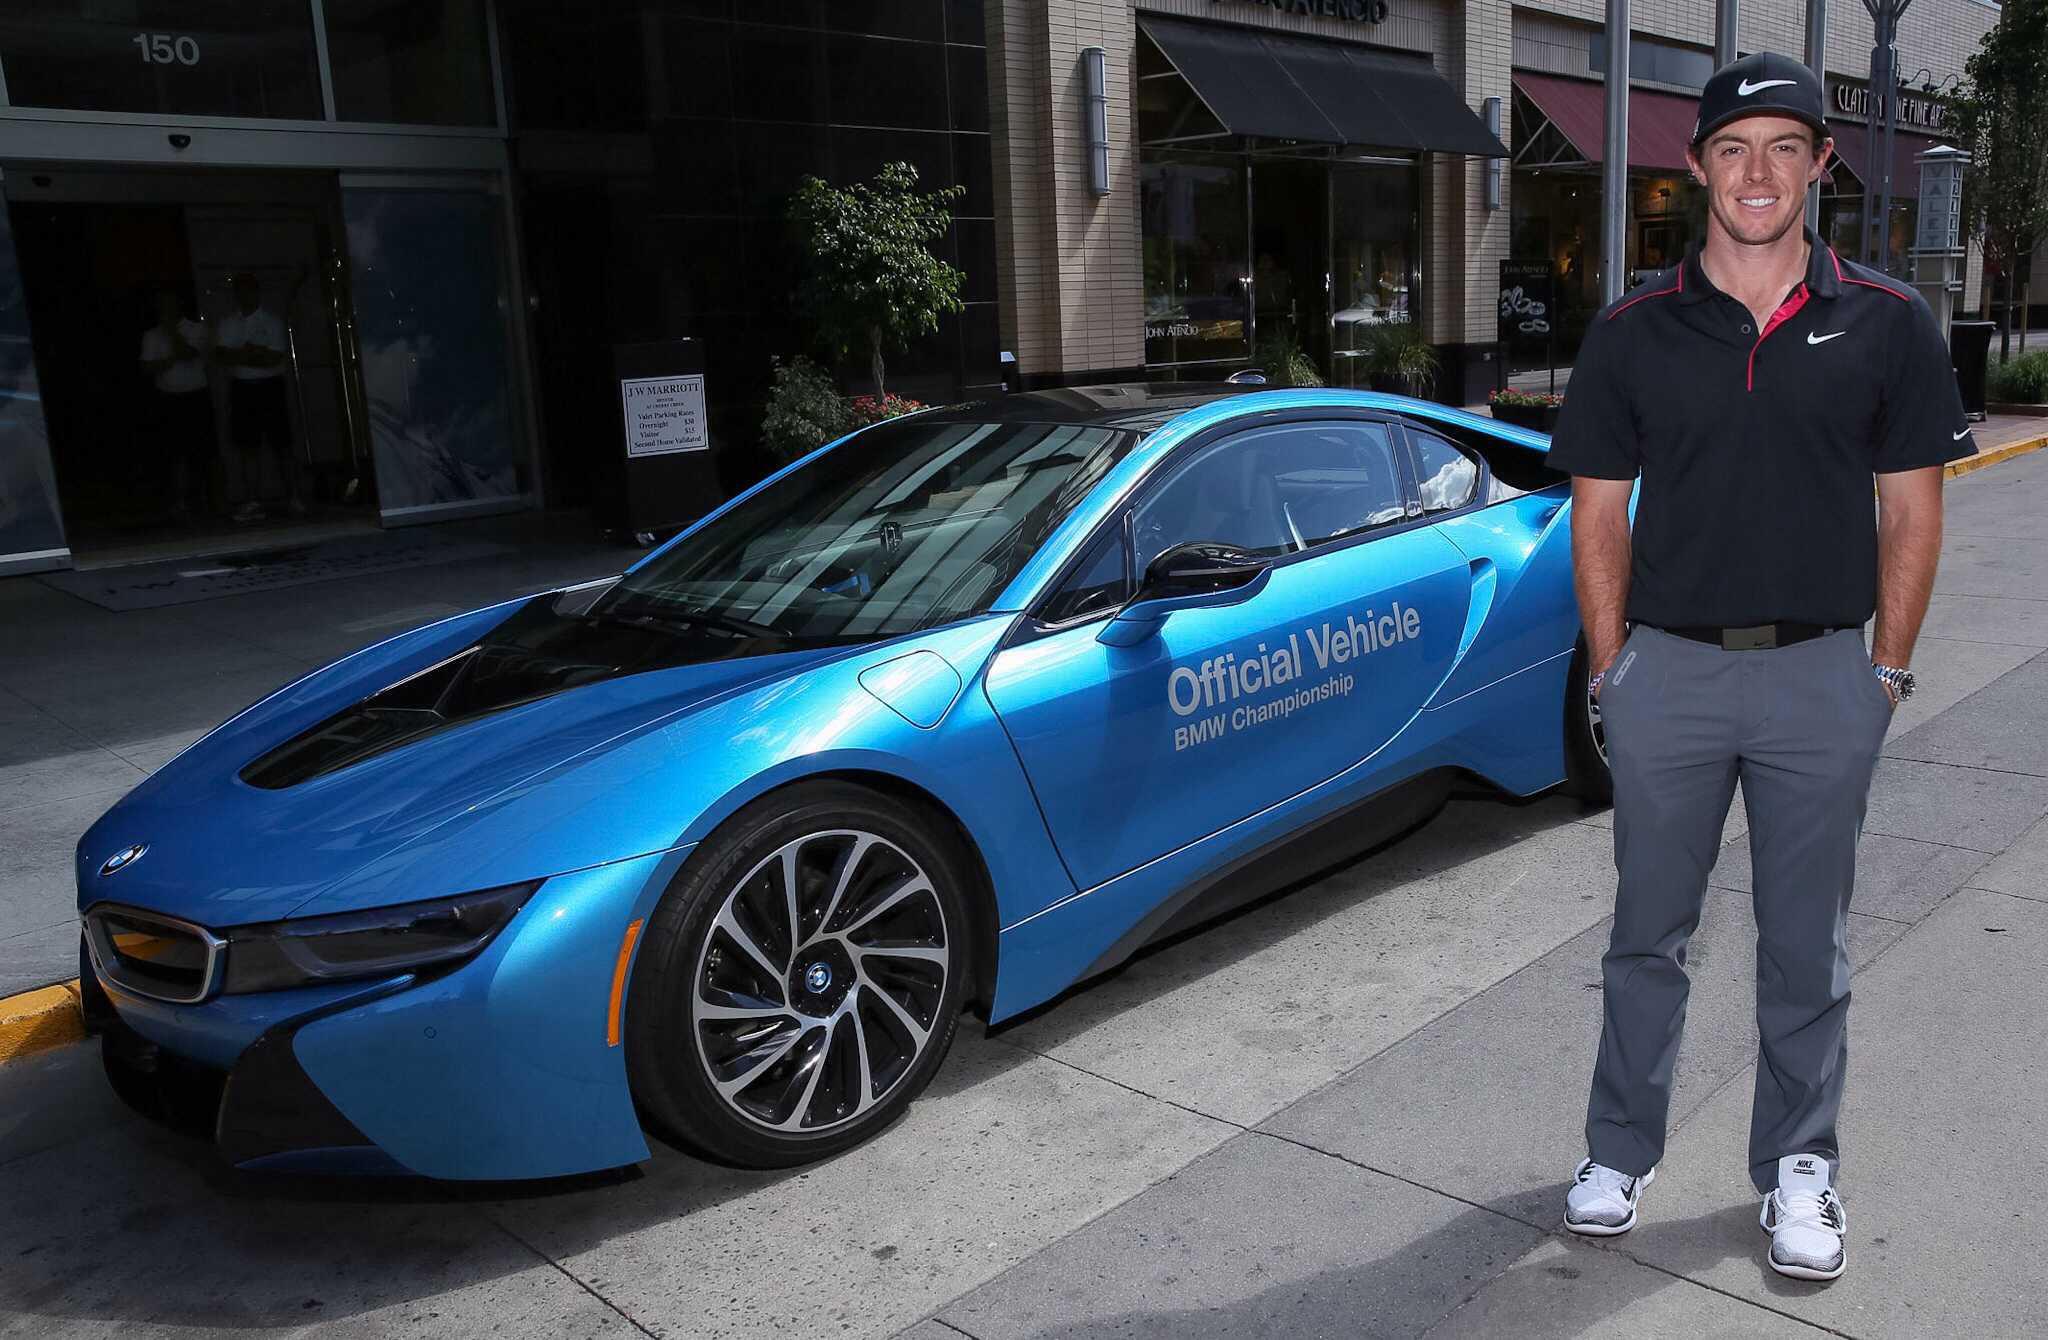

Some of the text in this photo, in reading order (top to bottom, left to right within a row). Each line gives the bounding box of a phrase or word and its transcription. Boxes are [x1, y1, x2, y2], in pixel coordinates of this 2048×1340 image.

[133, 33, 199, 65] 150
[1909, 99, 1928, 125] FINE
[1145, 325, 1199, 339] JOHN ATENCIO
[635, 387, 645, 396] W
[648, 383, 699, 395] MARRIOTT
[654, 411, 677, 419] Parking
[639, 421, 669, 429] Overnight
[634, 440, 656, 448] Second
[675, 435, 702, 443] Validated
[1168, 601, 1421, 716] Official Vehicle
[1174, 673, 1354, 751] BMW Championship
[1796, 1160, 1815, 1168] NIKE
